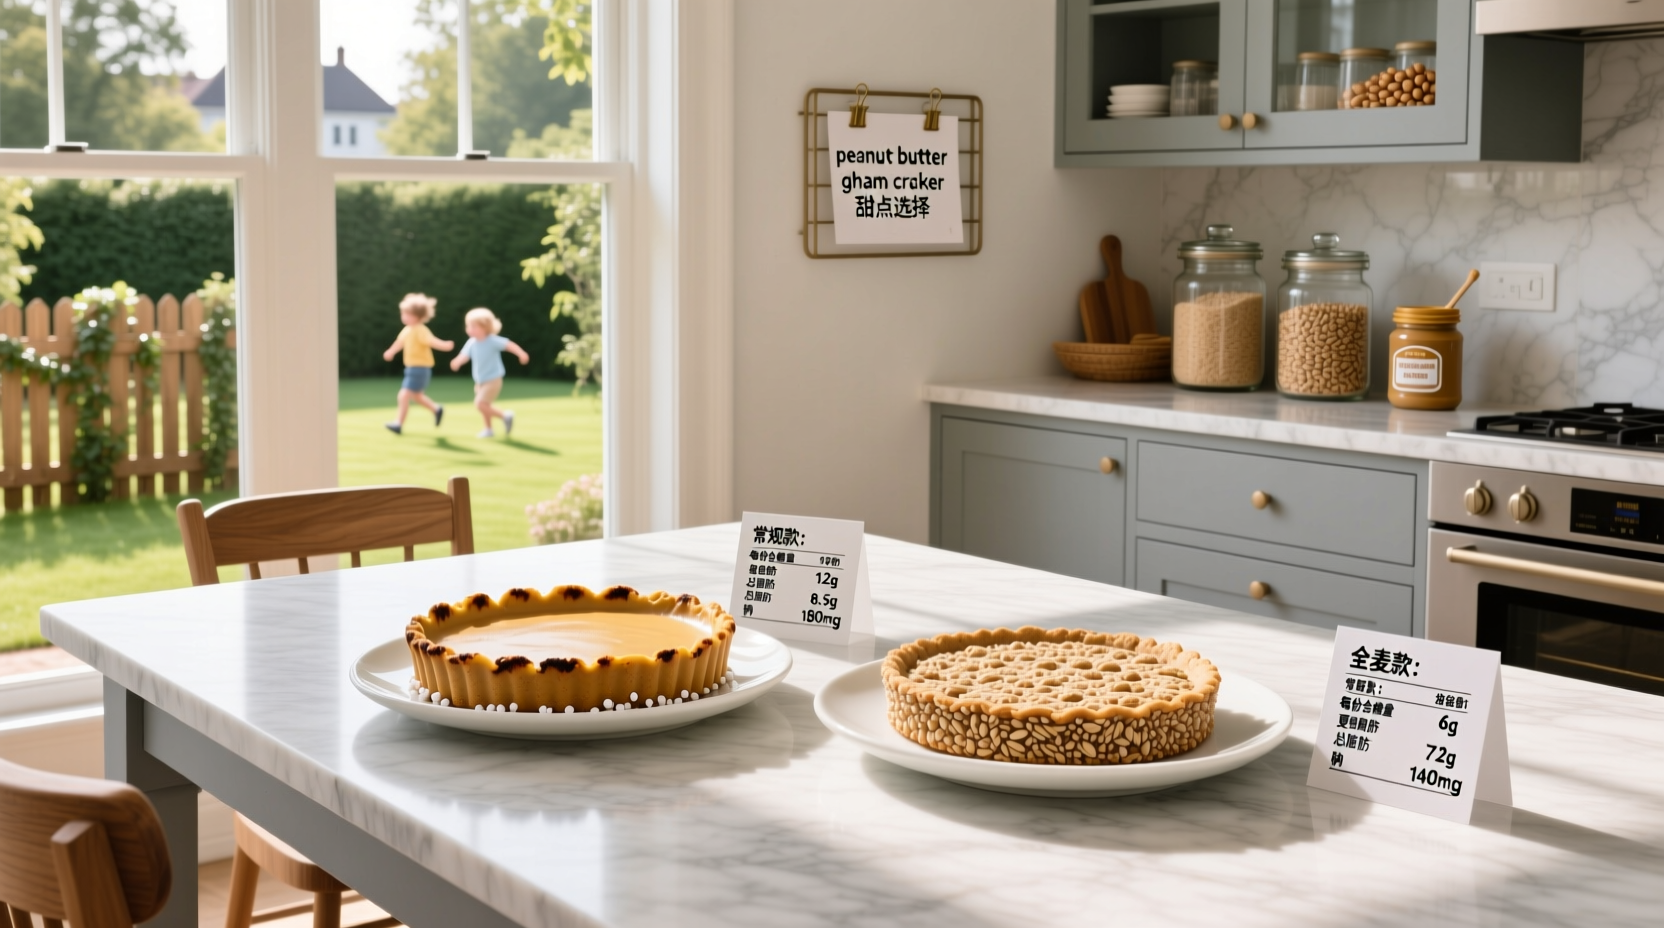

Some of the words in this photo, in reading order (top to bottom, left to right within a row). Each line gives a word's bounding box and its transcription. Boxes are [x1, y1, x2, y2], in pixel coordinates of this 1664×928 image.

[836, 148, 894, 168] peanut
[897, 145, 948, 166] butter
[841, 171, 888, 194] gham
[855, 194, 931, 219] 甜点选择
[815, 572, 839, 589] 12g
[810, 593, 838, 610] 8.5g
[1438, 714, 1459, 737] 6g
[1425, 743, 1457, 769] 72g
[1409, 766, 1463, 797] 140mg
